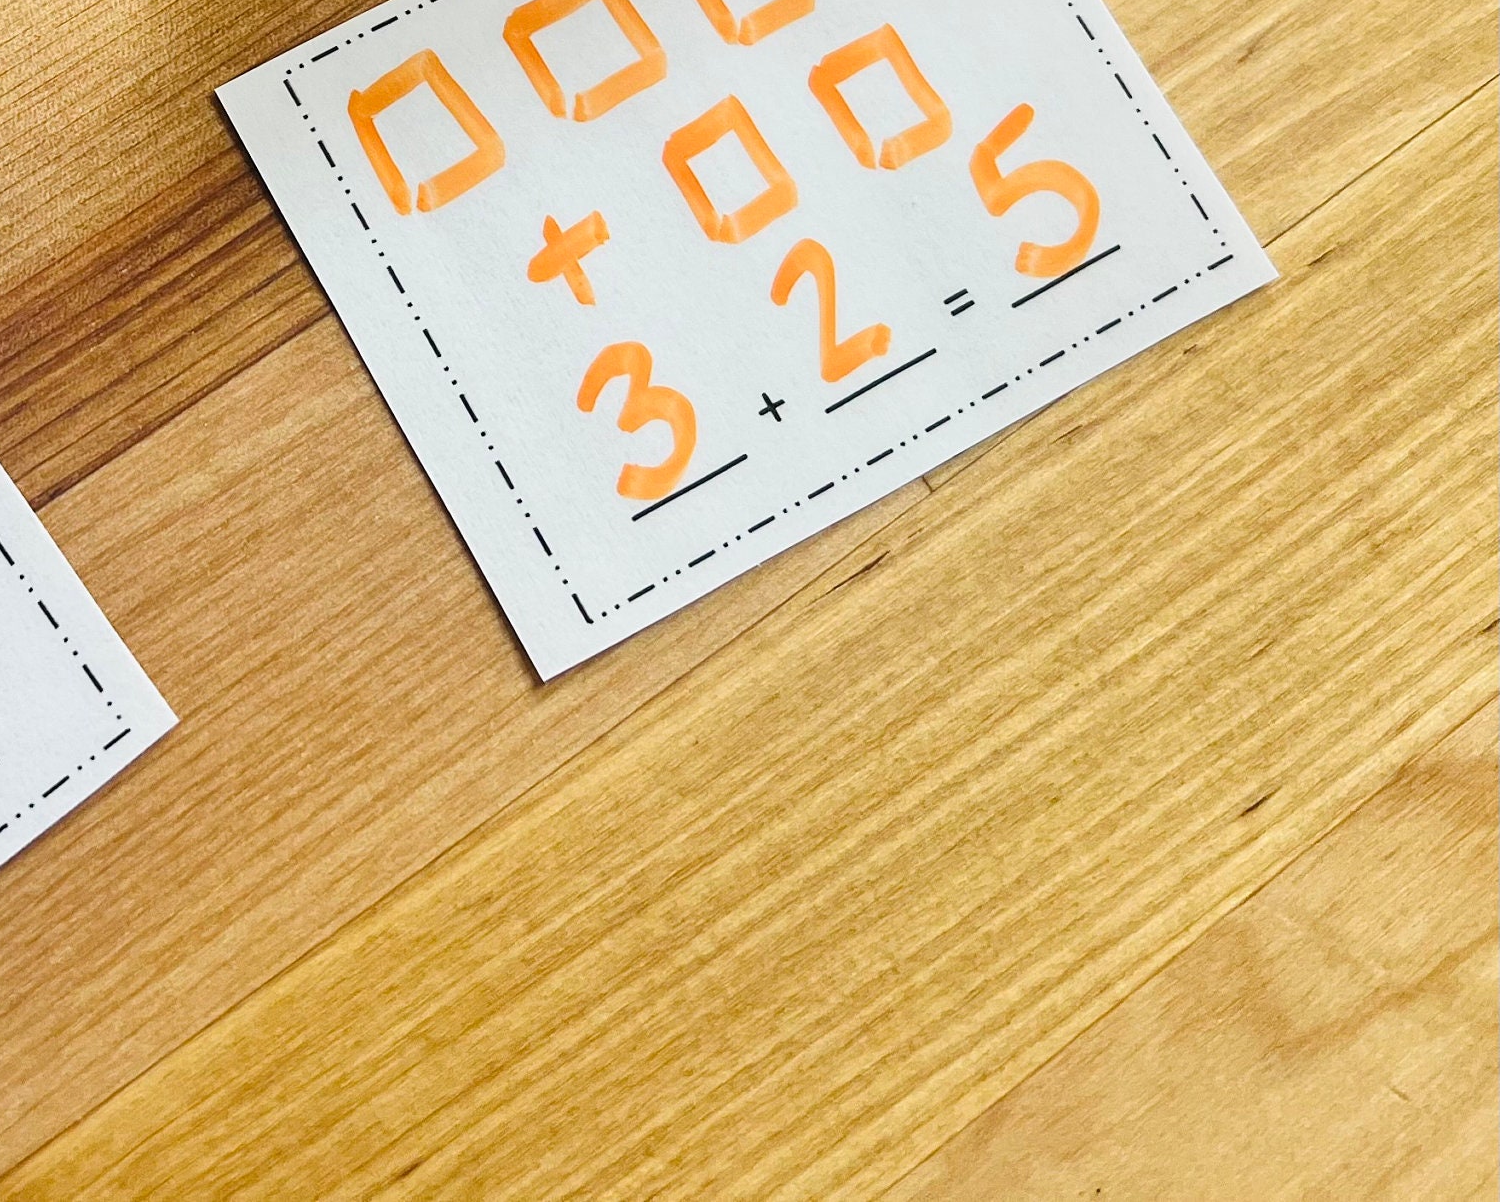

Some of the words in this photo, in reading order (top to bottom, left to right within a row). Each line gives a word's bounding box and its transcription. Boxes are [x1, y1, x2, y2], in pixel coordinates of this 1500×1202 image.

[576, 341, 697, 500] 3
[770, 238, 891, 383] 2
[969, 102, 1101, 278] 5
